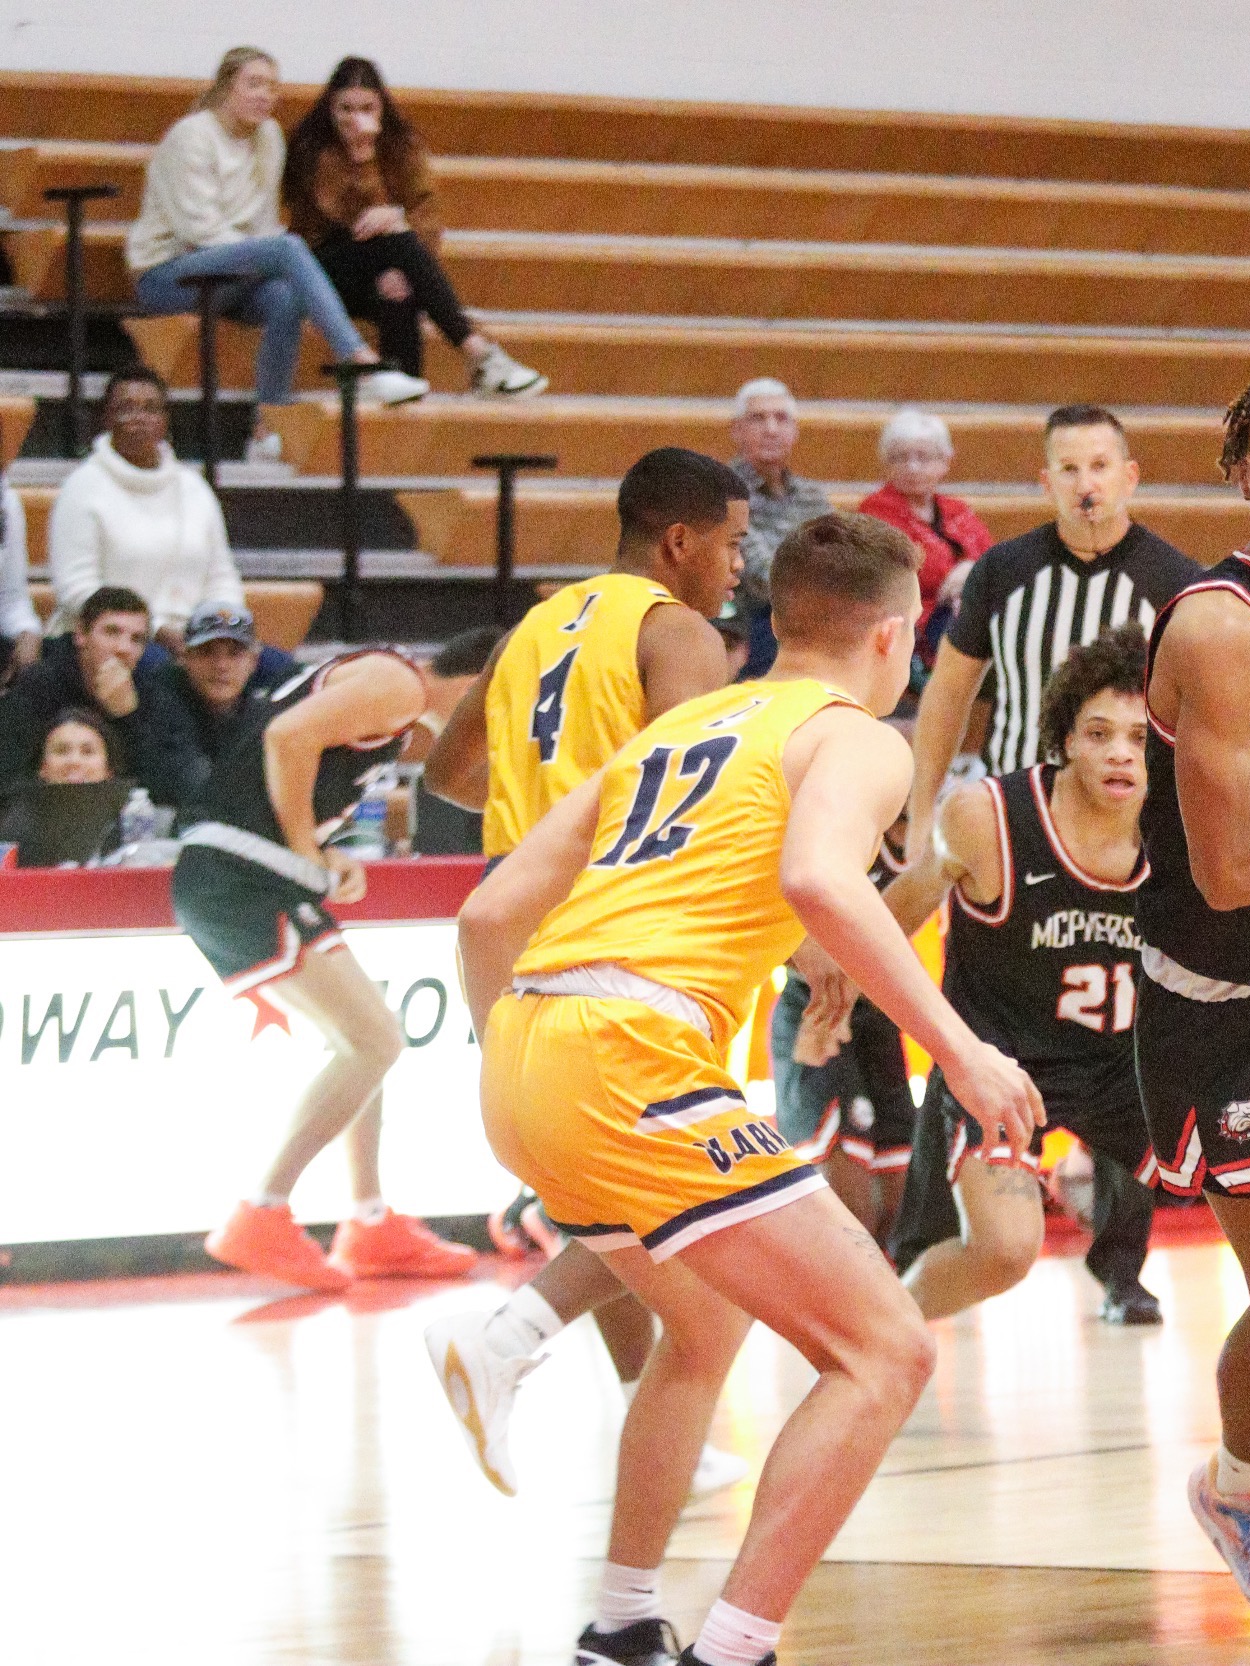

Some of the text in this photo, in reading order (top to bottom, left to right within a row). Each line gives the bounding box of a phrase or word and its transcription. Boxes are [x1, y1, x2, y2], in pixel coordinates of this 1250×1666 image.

[532, 646, 579, 763] 4
[590, 734, 741, 868] 12
[0, 986, 205, 1065] WAY
[1056, 961, 1137, 1033] 21
